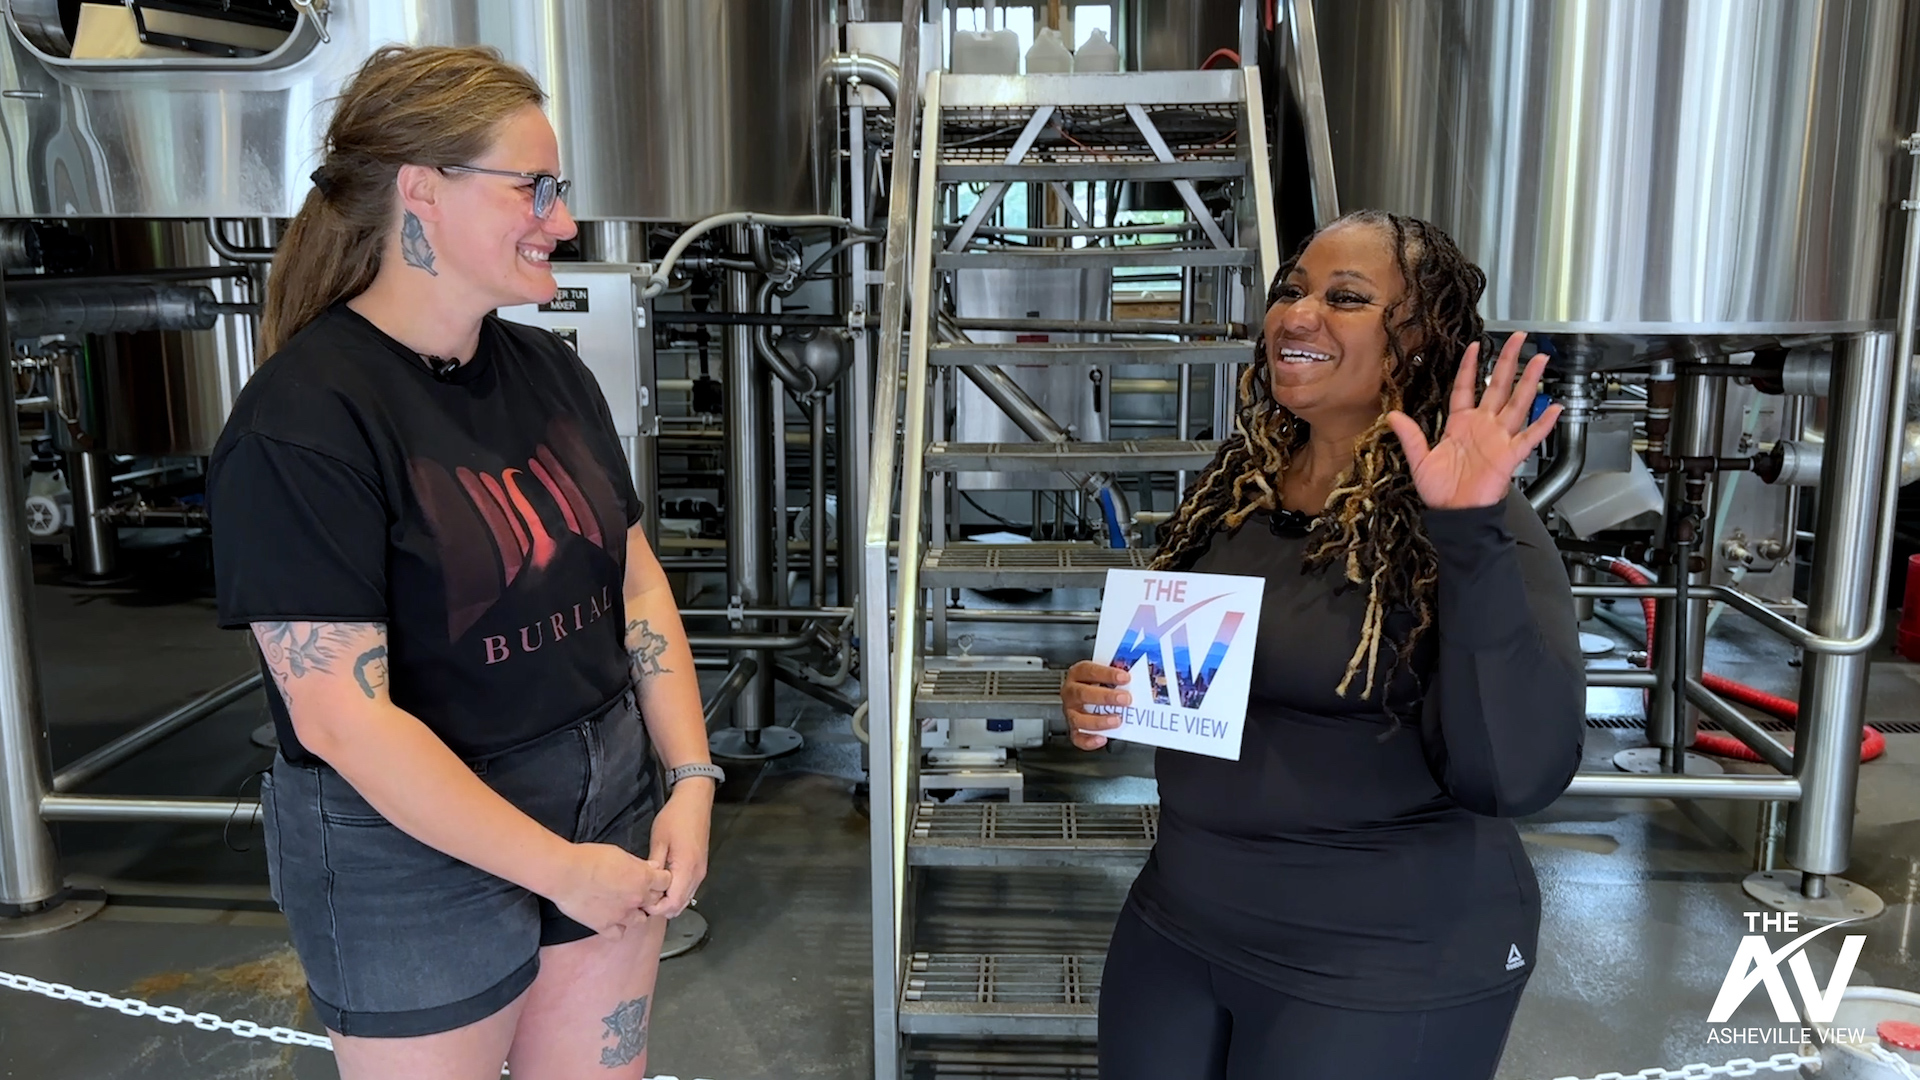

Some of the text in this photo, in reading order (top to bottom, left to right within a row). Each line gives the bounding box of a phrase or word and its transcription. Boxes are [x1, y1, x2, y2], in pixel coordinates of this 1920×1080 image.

[550, 301, 577, 310] MIXER
[571, 290, 587, 299] TUN
[1143, 578, 1188, 603] THE
[482, 585, 612, 665] BURIAL
[1098, 600, 1245, 710] AV
[1184, 714, 1229, 739] VIEW
